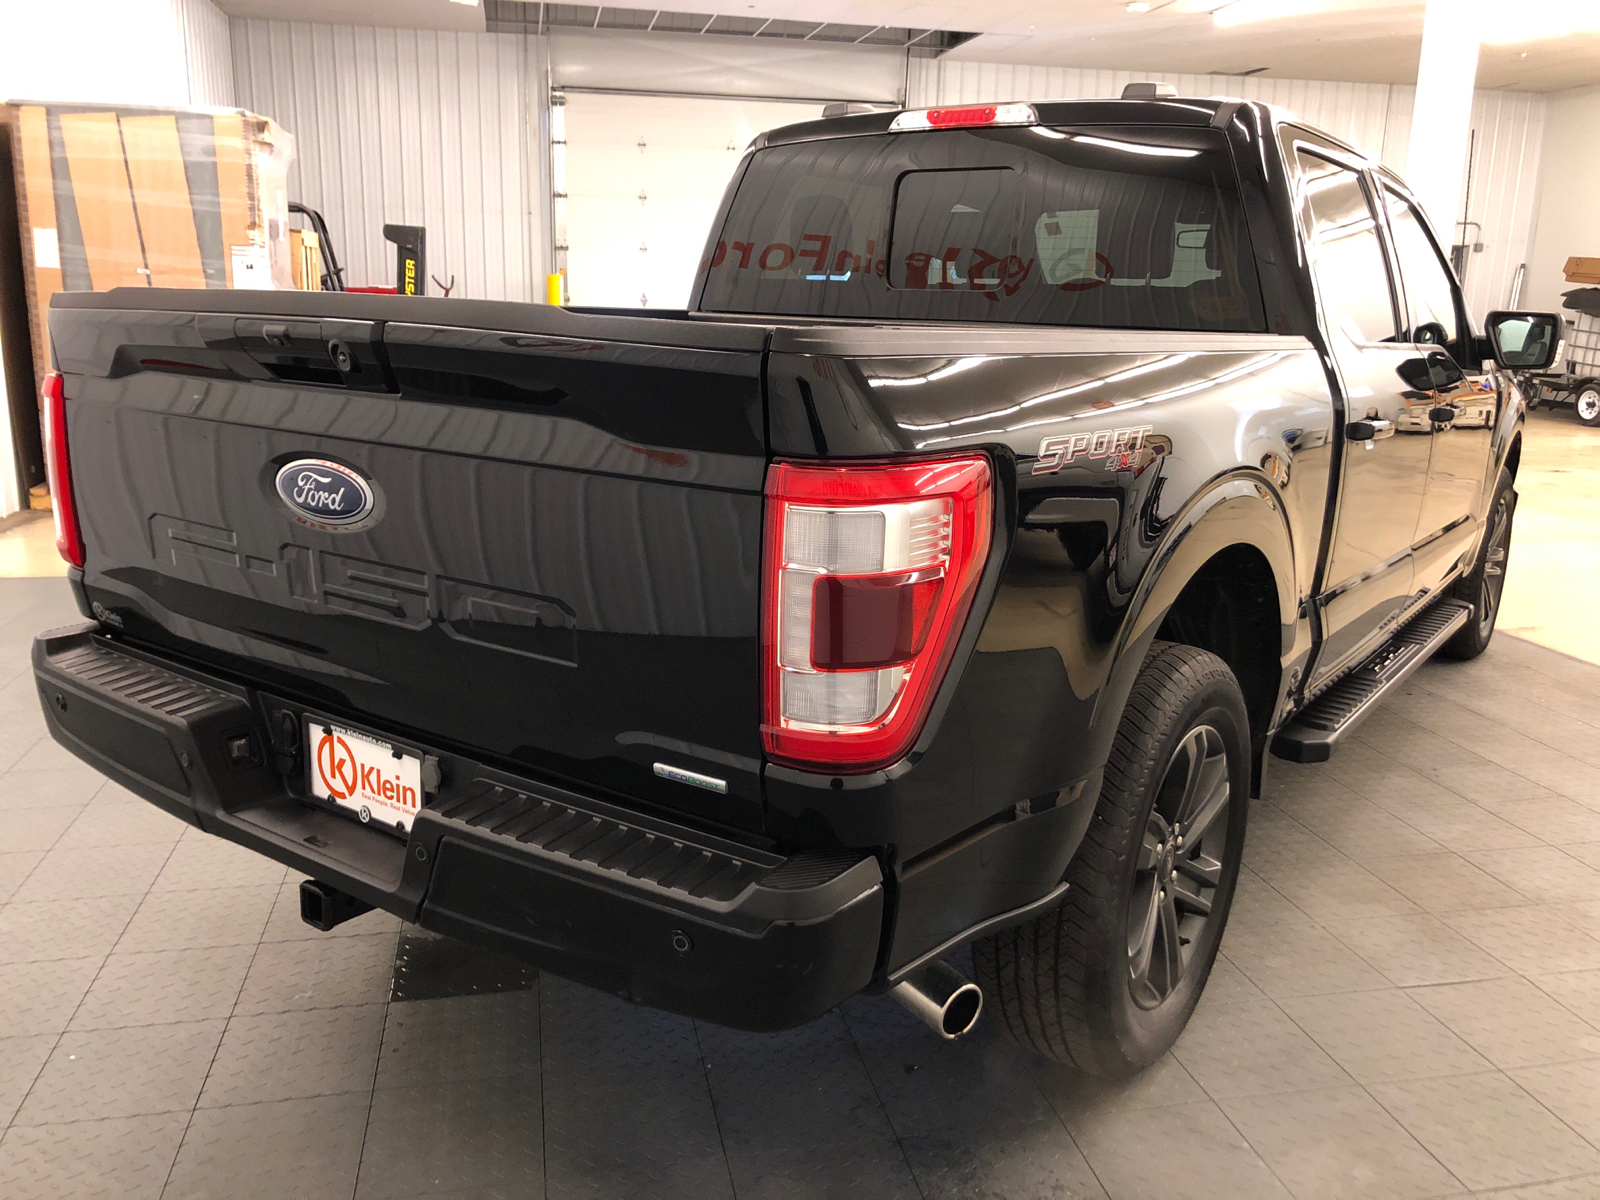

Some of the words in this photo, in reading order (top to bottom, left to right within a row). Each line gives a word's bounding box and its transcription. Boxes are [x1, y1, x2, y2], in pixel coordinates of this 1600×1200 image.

[405, 258, 416, 297] STER
[1032, 425, 1153, 475] SPORT
[293, 471, 345, 511] Ford
[148, 513, 578, 668] F-150
[360, 763, 416, 808] Klein
[361, 792, 372, 801] Real
[390, 802, 401, 812] Real
